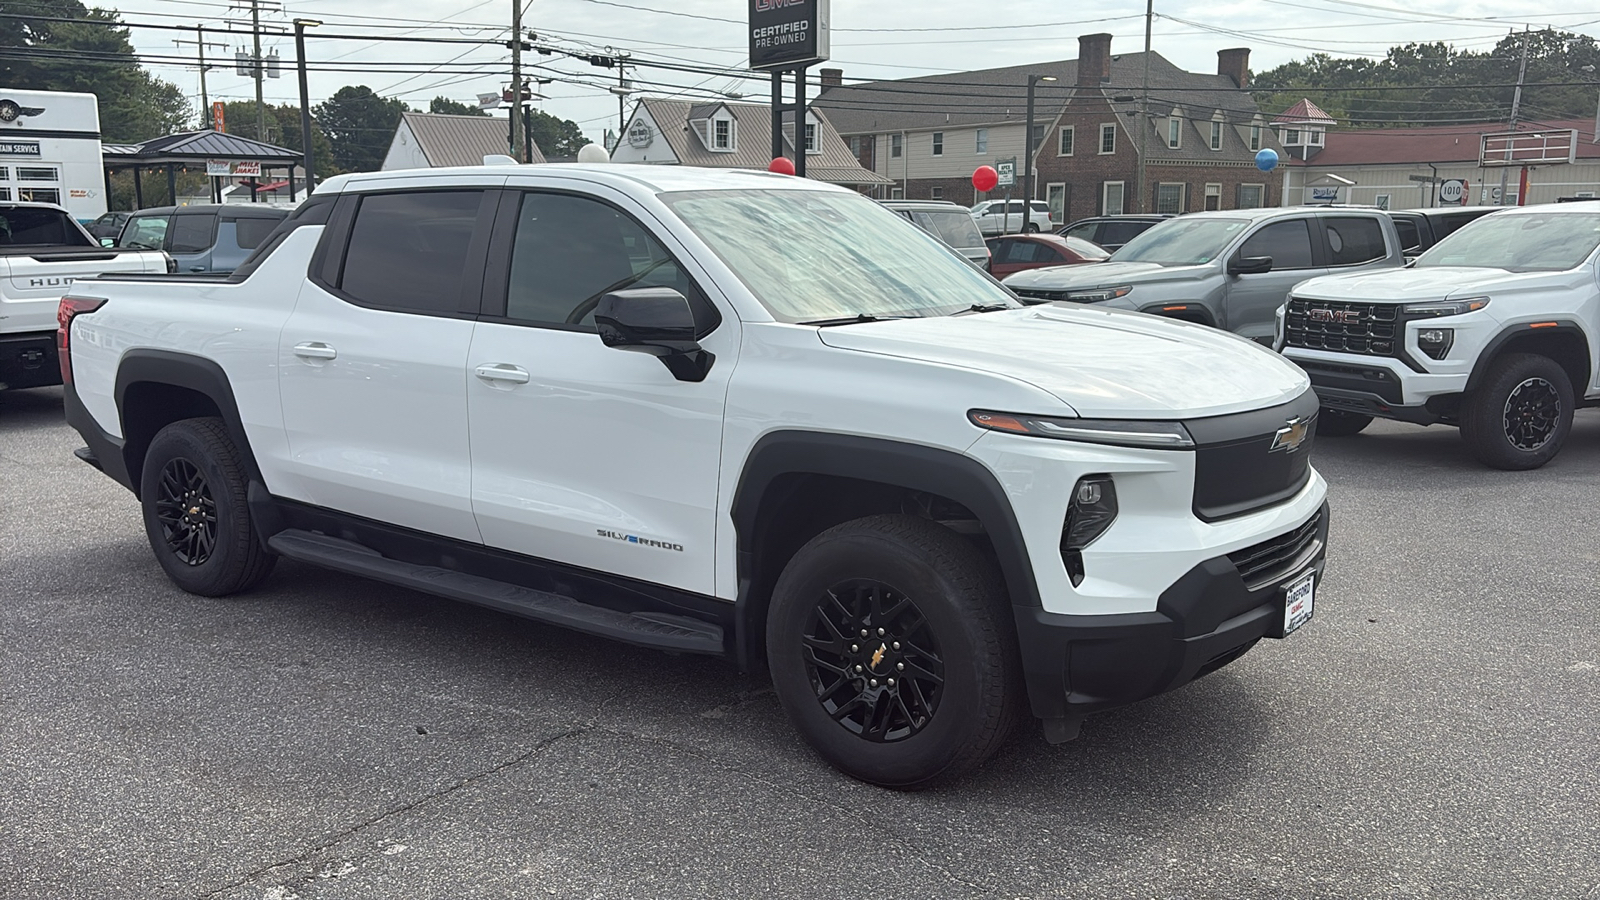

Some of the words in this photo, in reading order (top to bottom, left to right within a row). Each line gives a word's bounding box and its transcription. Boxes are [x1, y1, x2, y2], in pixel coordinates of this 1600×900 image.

[753, 20, 808, 38] CERTIFIED
[756, 32, 806, 48] PRE-OWNED
[13, 145, 38, 153] SERVICE
[1309, 308, 1360, 325] GMC
[596, 529, 683, 552] SILVERADO
[1287, 582, 1311, 607] BAREFORD
[1291, 600, 1304, 615] GMC
